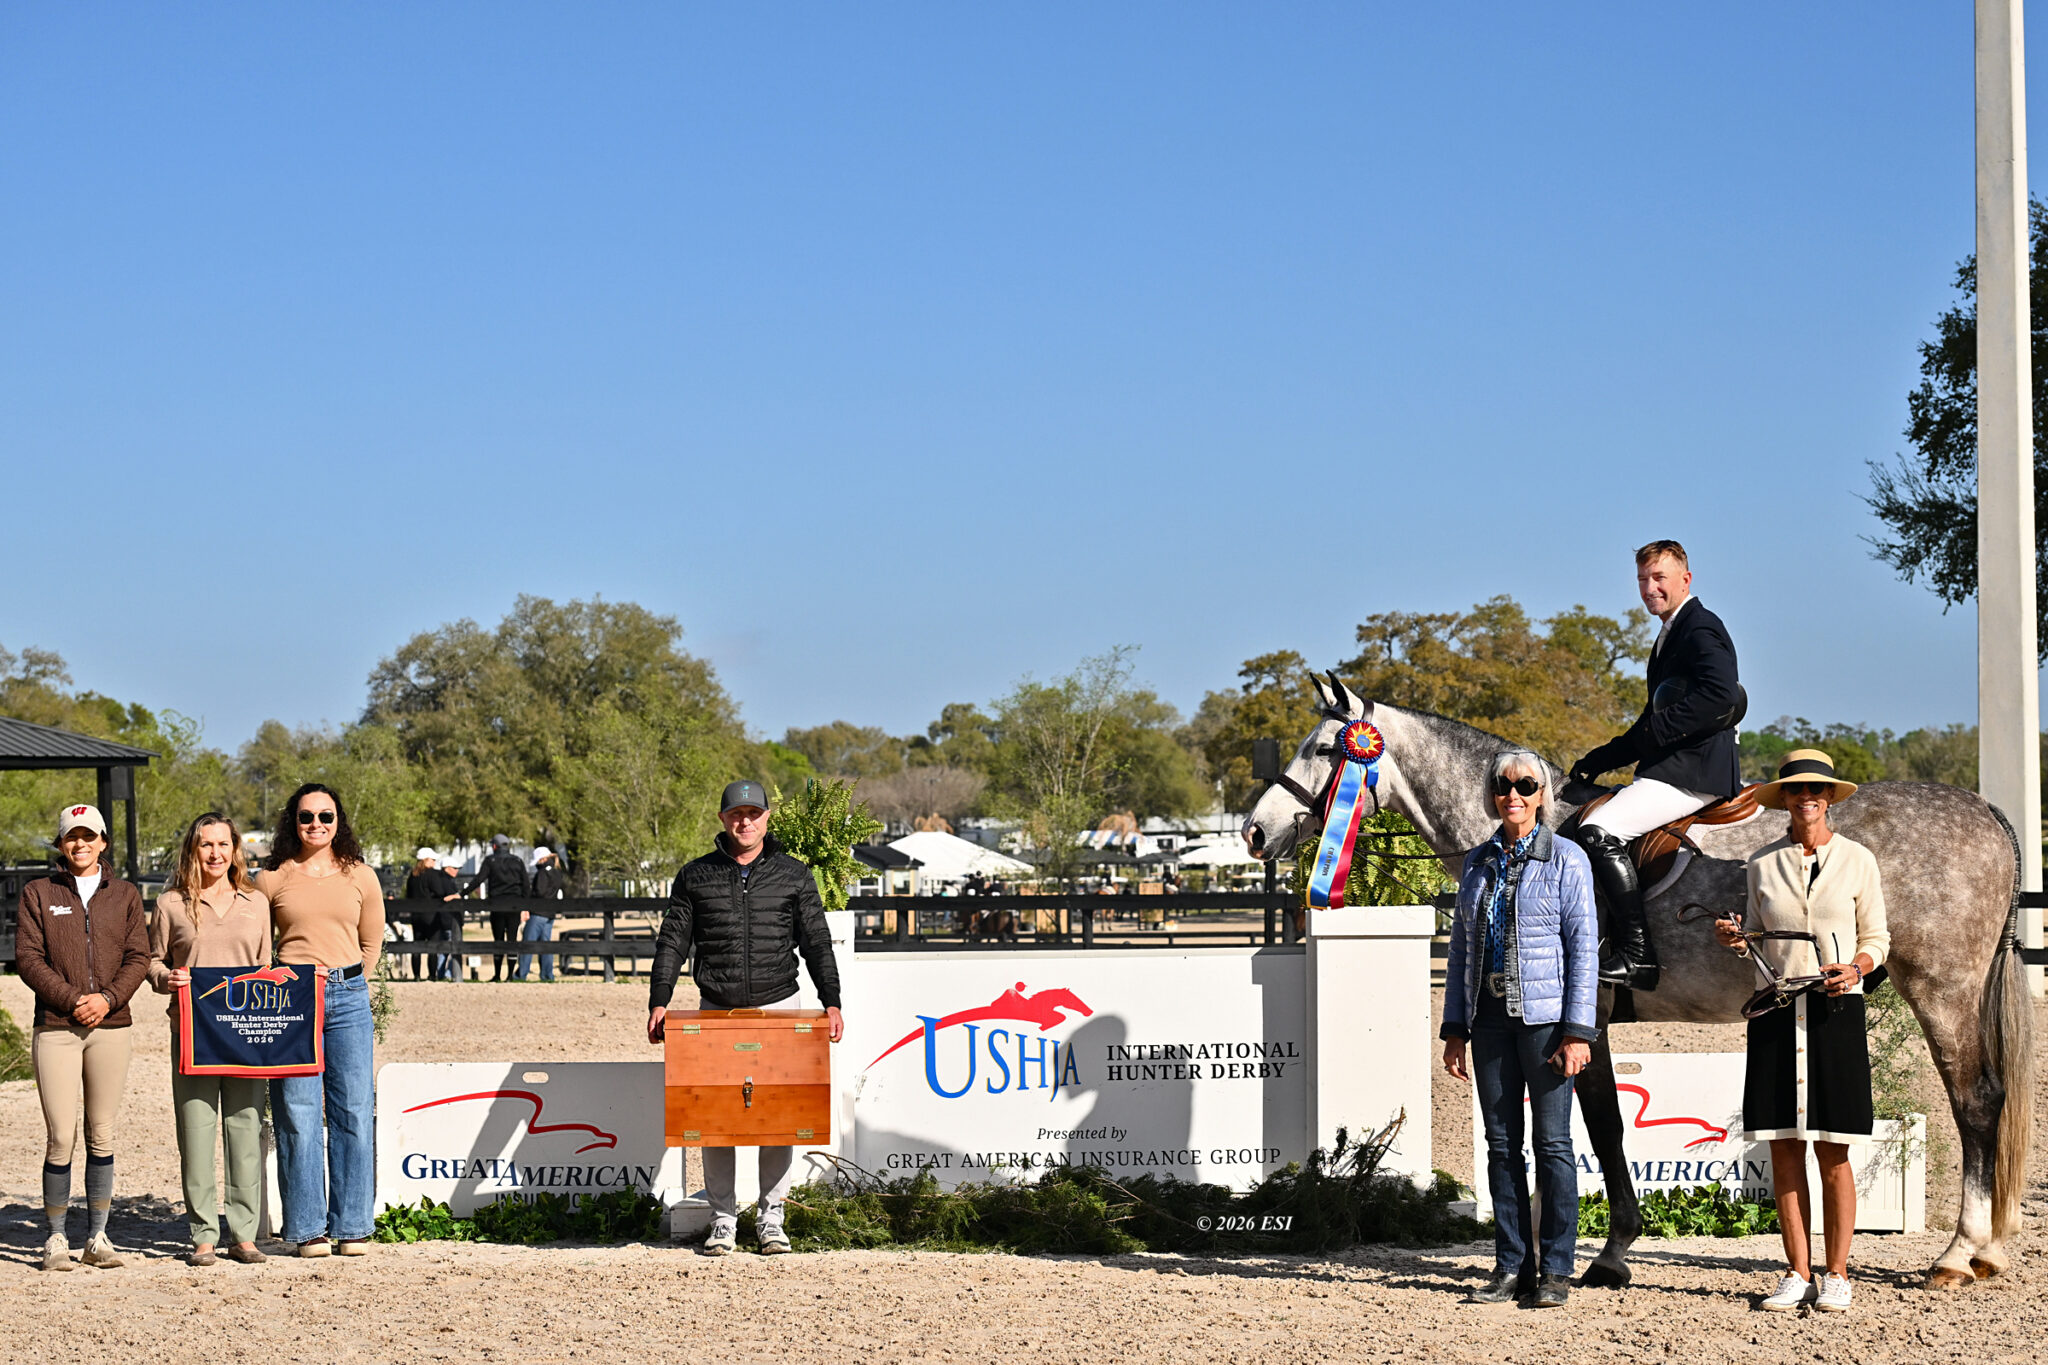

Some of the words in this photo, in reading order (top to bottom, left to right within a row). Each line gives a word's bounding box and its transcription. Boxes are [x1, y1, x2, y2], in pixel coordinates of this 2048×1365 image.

[71, 806, 87, 817] W
[222, 976, 293, 1014] USHJA
[215, 1014, 248, 1022] USHJA
[248, 1014, 304, 1022] International
[262, 1022, 289, 1030] Derby
[238, 1028, 282, 1037] Champion
[246, 1036, 274, 1044] 2026
[915, 1015, 1082, 1103] USHJA
[1106, 1042, 1300, 1061] INTERNATIONAL
[1106, 1064, 1203, 1081] HUNTER
[1210, 1062, 1286, 1079] DERBY
[1036, 1126, 1107, 1140] Presented
[1111, 1126, 1128, 1143] by
[886, 1152, 954, 1169] GREAT
[960, 1151, 1072, 1169] AMERICAN
[1081, 1150, 1202, 1167] INSURANCE
[1210, 1148, 1281, 1164] GROUP
[1602, 1161, 1768, 1182] MERICAN
